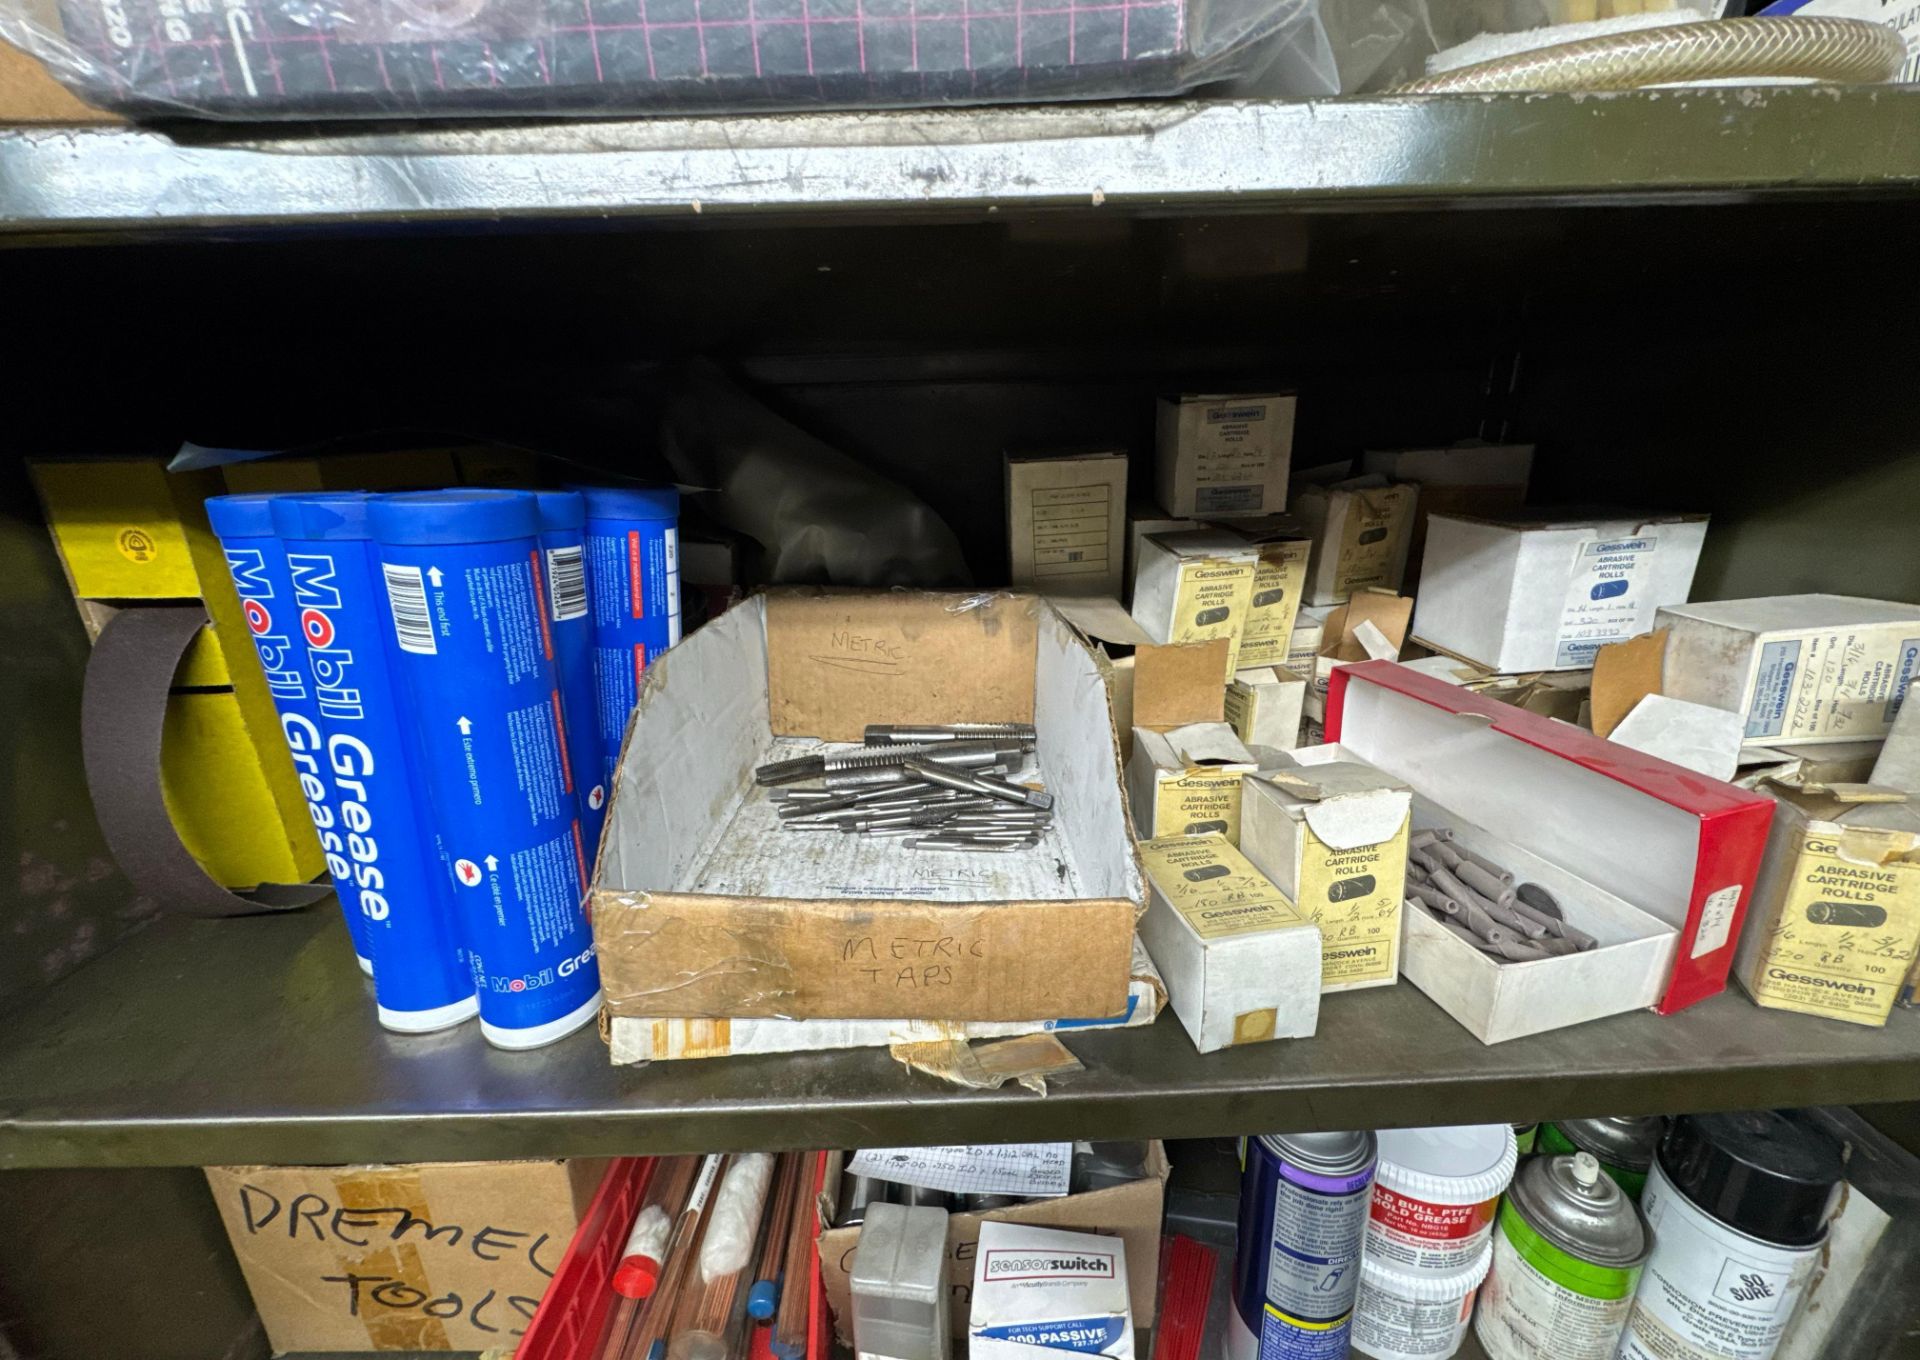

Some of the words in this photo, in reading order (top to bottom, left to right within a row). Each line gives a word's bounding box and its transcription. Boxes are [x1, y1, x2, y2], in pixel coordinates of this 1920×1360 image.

[1596, 541, 1647, 553] Gesswein
[1598, 555, 1635, 563] ABRASIVE
[1195, 568, 1243, 579] Gesswein
[1257, 566, 1287, 575] ABRASIVE
[1592, 563, 1636, 572] CARTRIDGE
[1598, 571, 1624, 579] ROLLS
[1254, 574, 1288, 582] CARTRIDGE
[1199, 583, 1234, 592] ABRASIVE
[434, 591, 445, 606] This
[1195, 591, 1234, 600] CARTRIDGE
[437, 607, 448, 622] end
[440, 621, 452, 637] first
[831, 632, 904, 660] METRIC
[1857, 670, 1872, 697] ROLLS
[1865, 660, 1884, 705] CARTRIDGE
[1876, 662, 1894, 703] ABRASIVE
[1772, 661, 1796, 720] Gesswein
[226, 550, 307, 700] Mobil
[281, 712, 352, 882] Grease
[287, 553, 364, 720] Mobil
[329, 733, 391, 922] Grease
[462, 737, 473, 752] Este
[464, 752, 477, 779] extremo
[1177, 777, 1240, 788] Gesswein
[469, 779, 482, 806] primero
[1184, 795, 1229, 803] ABRASIVE
[1180, 803, 1232, 811] CARTRIDGE
[1190, 811, 1220, 819] ROLLS
[1150, 839, 1213, 850] Gesswein
[1329, 844, 1378, 857] ABRASIVE
[1167, 849, 1211, 858] ABRASIVE
[1167, 854, 1219, 864] CARTRIDGE
[1325, 854, 1380, 867] CARTRIDGE
[1181, 860, 1212, 868] ROLLS
[1335, 865, 1367, 875] ROLLS
[1814, 864, 1897, 883] ABRASIVE
[1806, 875, 1899, 894] CARTRIDGE
[489, 873, 498, 883] Ce
[494, 904, 506, 927] premier
[1822, 887, 1875, 902] ROLLS
[1201, 904, 1275, 919] Gesswein
[842, 937, 988, 962] METRIC
[1872, 936, 1911, 961] 3/32
[860, 966, 952, 988] TAPS
[1865, 964, 1886, 975] 100
[491, 969, 555, 993] Mobil
[1768, 968, 1876, 996] Gesswein
[1833, 991, 1875, 1003] AVENUE
[1292, 1198, 1304, 1206] job
[1306, 1203, 1324, 1212] done
[1330, 1199, 1343, 1207] rely
[1398, 1200, 1434, 1215] BULL
[1442, 1207, 1473, 1217] PTFE
[1372, 1197, 1409, 1216] MOLD
[1414, 1213, 1468, 1225] GREASE
[1384, 1217, 1395, 1226] Net
[1397, 1223, 1409, 1231] Wt.
[1386, 1212, 1404, 1222] Part
[1405, 1219, 1419, 1227] No.
[990, 1256, 1109, 1273] sensorswitch
[1740, 1273, 1765, 1288] SO
[1555, 1286, 1573, 1297] See
[1662, 1284, 1687, 1308] Water
[1729, 1284, 1774, 1302] SURE
[1554, 1291, 1609, 1313] Information
[1651, 1267, 1706, 1313] CORROSION
[1708, 1311, 1767, 1332] PREVENTIVE
[1038, 1323, 1067, 1331] SUPPORT
[1067, 1321, 1086, 1329] CALL:
[1681, 1315, 1711, 1335] Grade
[1737, 1334, 1757, 1345] Type
